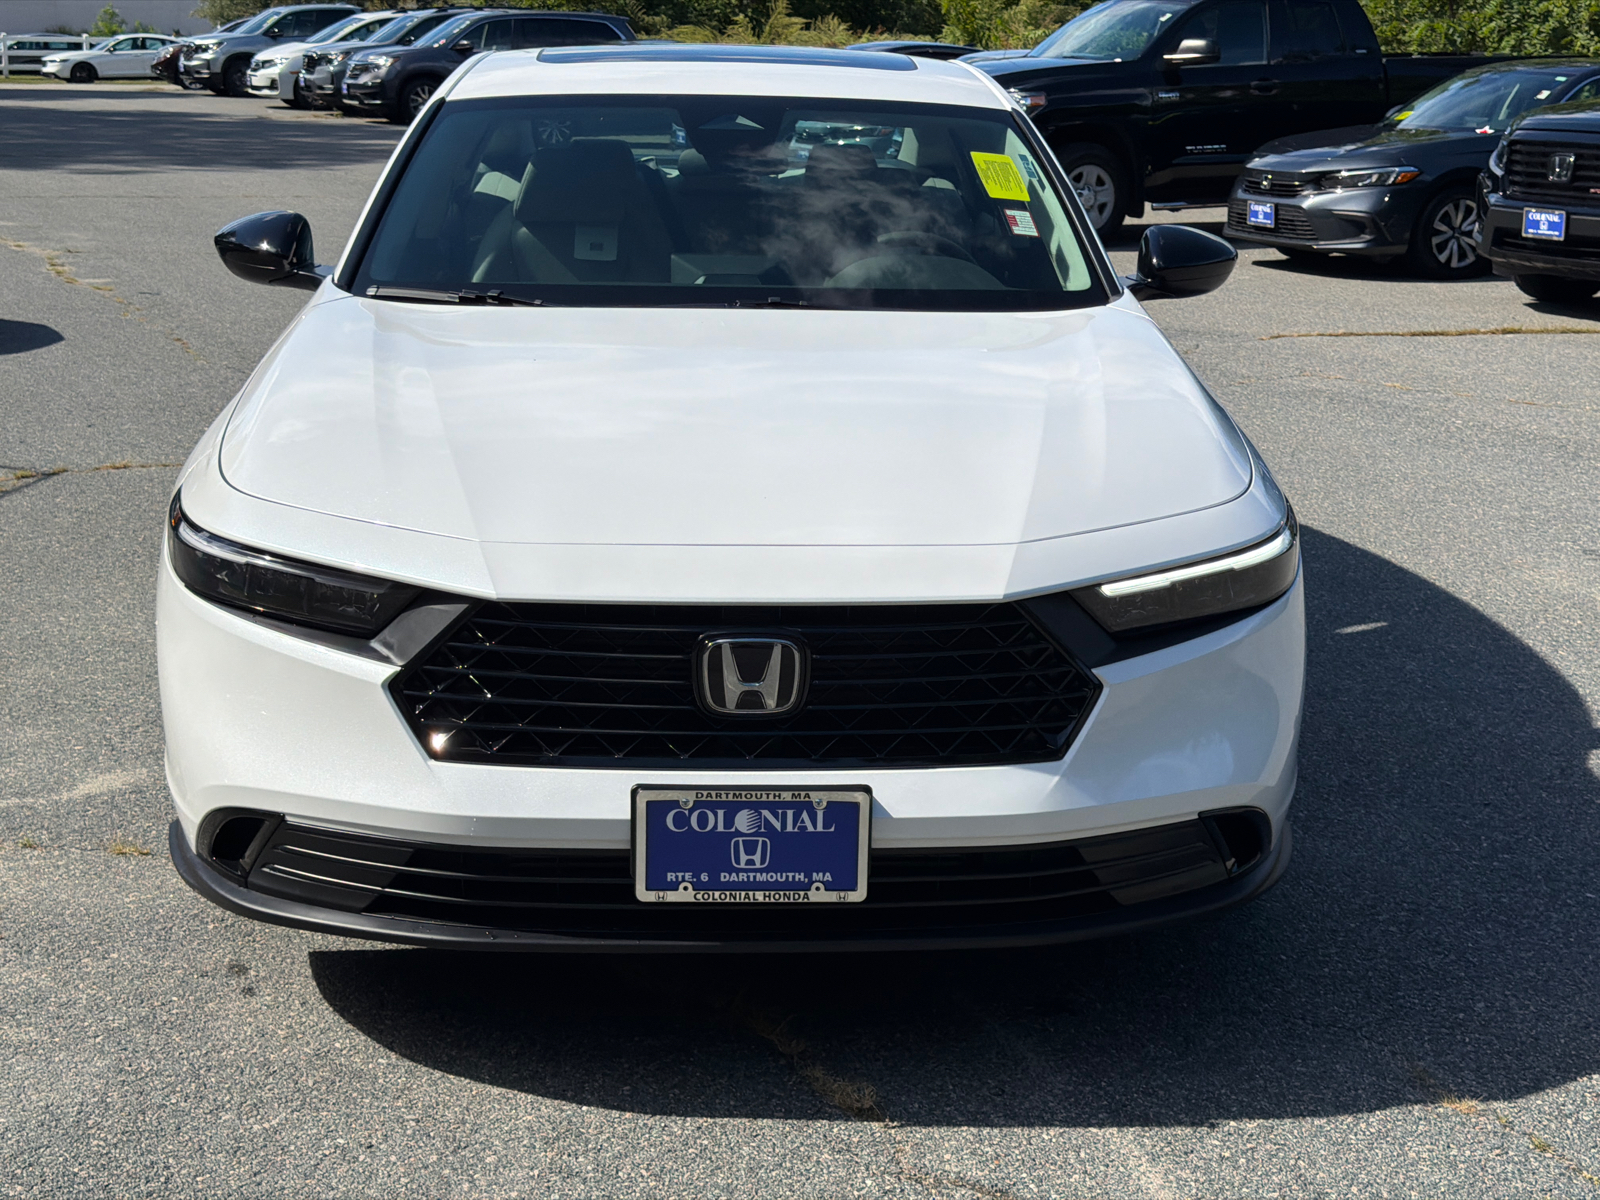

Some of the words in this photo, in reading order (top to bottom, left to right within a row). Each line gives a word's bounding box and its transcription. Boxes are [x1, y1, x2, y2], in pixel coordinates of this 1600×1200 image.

[695, 791, 787, 800] DARTMOUTH,
[791, 791, 811, 800] MA
[666, 808, 835, 834] COLONIAL
[666, 872, 697, 882] RTE.
[701, 872, 709, 882] 6
[720, 872, 808, 883] DARTMOUTH,
[812, 872, 832, 882] MA
[693, 892, 759, 902] COLONIAL
[763, 892, 810, 902] HONDA
